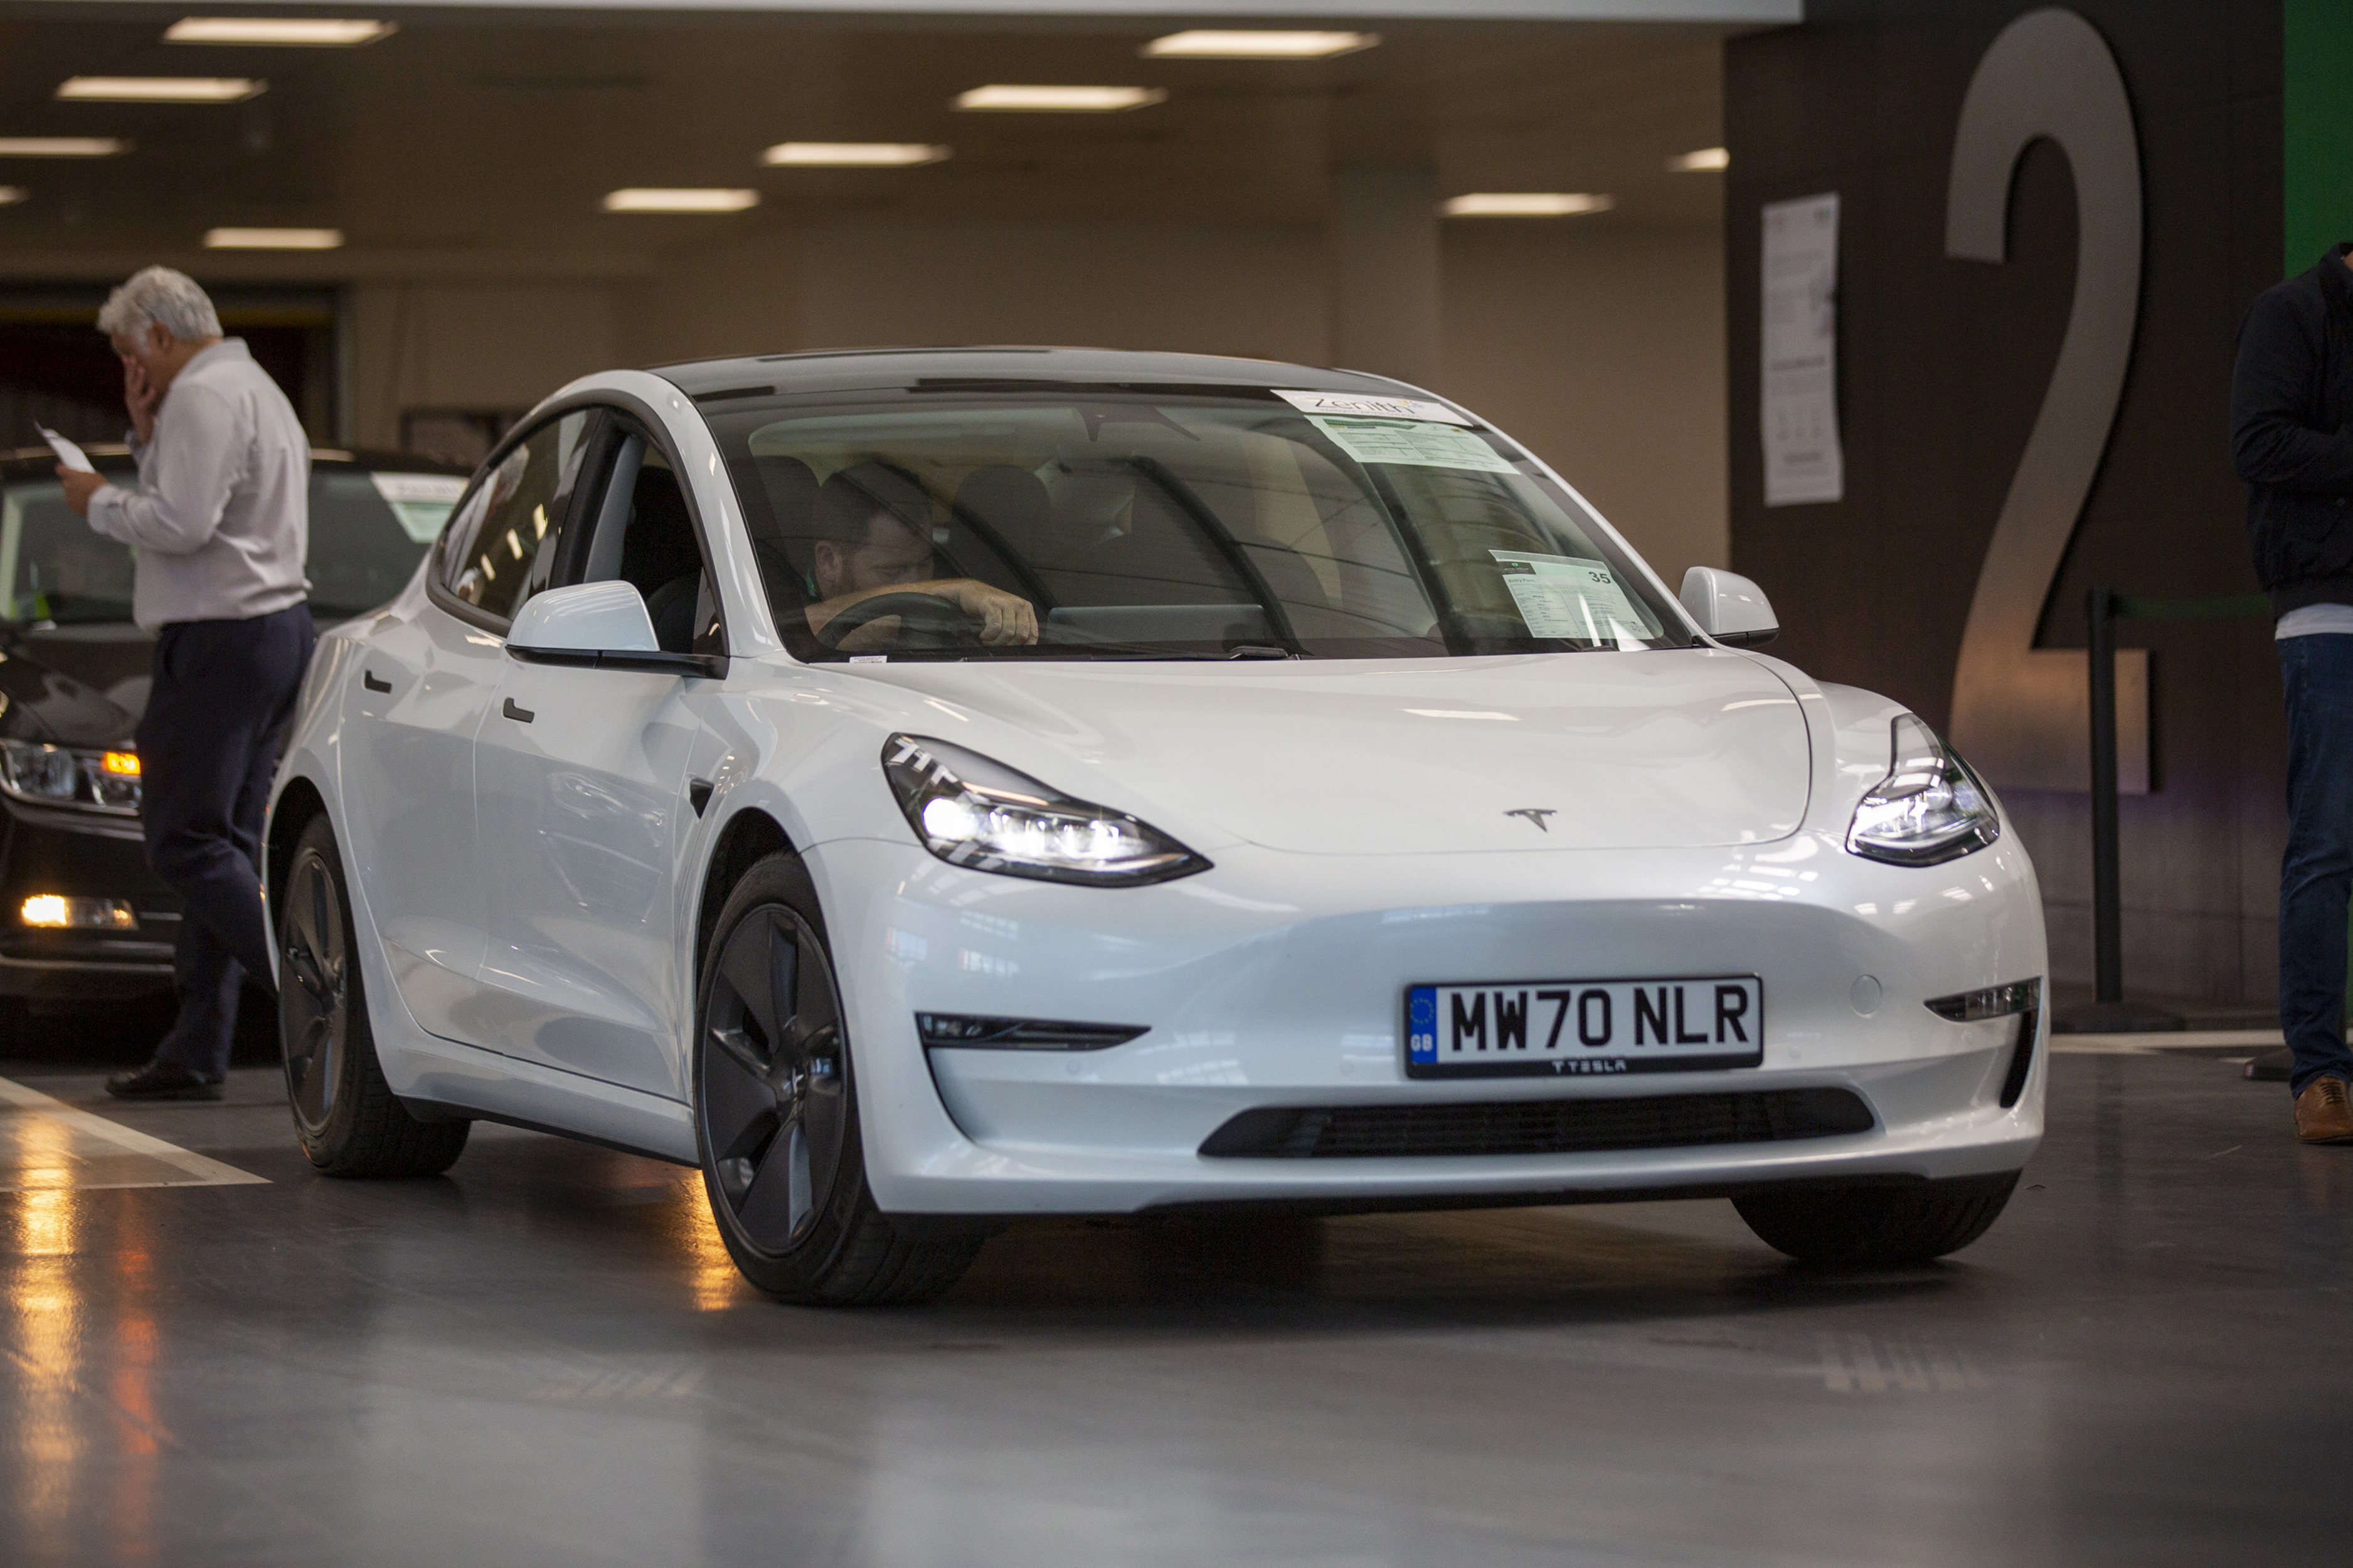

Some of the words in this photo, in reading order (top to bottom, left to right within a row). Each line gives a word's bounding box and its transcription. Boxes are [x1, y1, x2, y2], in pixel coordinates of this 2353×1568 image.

[1307, 398, 1415, 414] Zenith
[1945, 8, 2149, 794] 2
[1588, 571, 1611, 584] 35
[1452, 989, 1612, 1051] MW70
[1634, 985, 1749, 1046] NLR
[1411, 1034, 1433, 1052] GB
[1567, 1059, 1627, 1073] TESLA
